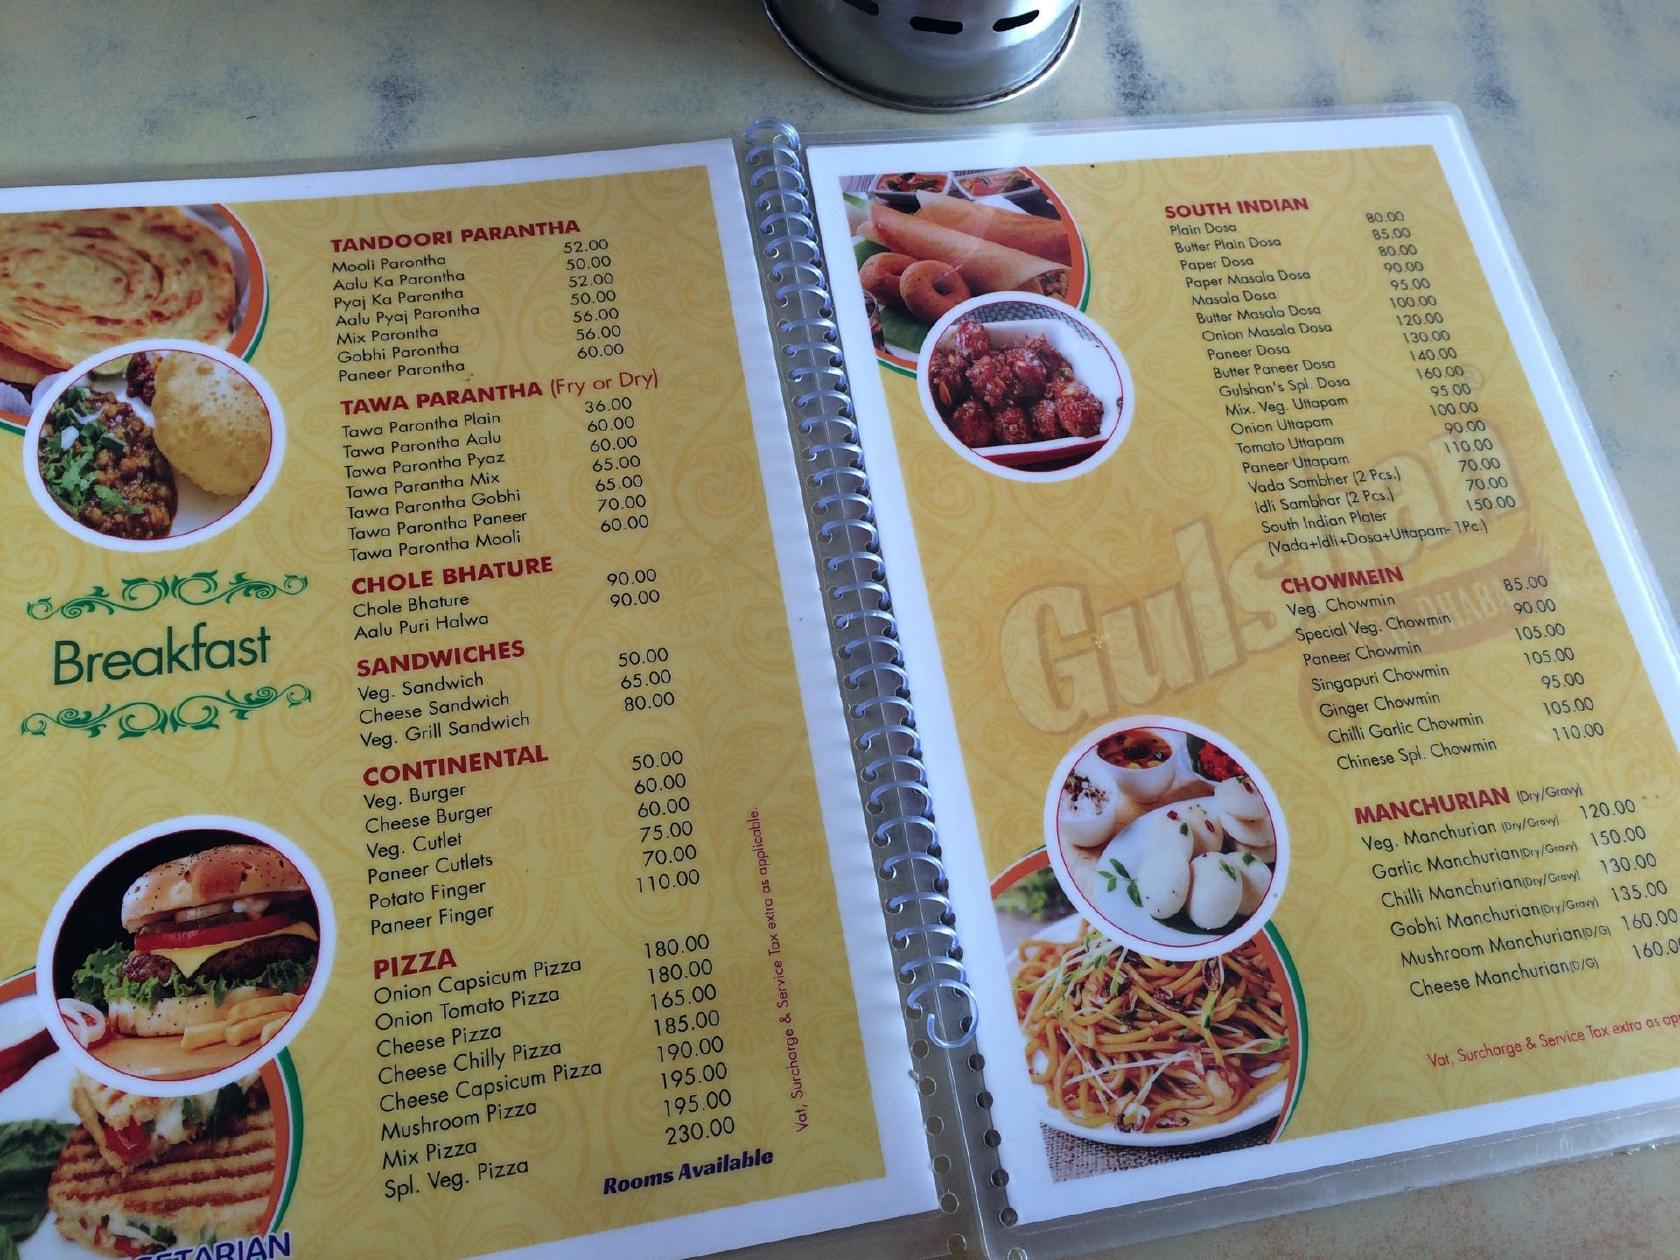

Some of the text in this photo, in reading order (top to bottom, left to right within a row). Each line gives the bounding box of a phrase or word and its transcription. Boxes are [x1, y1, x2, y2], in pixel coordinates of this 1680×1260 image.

[1164, 198, 1309, 219] SOUTH INDIAN
[1169, 211, 1404, 235] Plain Dosa 80.00
[330, 219, 581, 253] TANDOORI PARANTHA
[332, 258, 375, 273] Mooli
[563, 238, 609, 254] 52.00
[1179, 244, 1417, 272] Paper Dosa 80.00
[335, 312, 370, 327] Aalu
[376, 310, 408, 327] Pyaj
[570, 290, 616, 306] 50.00
[1192, 277, 1431, 306] Masala Dosa 95.00
[338, 369, 392, 382] Paneer
[577, 342, 624, 360] 60.00
[1207, 330, 1450, 360] Paneer Dosa 130.00
[340, 368, 658, 416] TAWA PARANTHA (Fry or Dry)
[1219, 365, 1464, 397] Gulshan's Spl. Dosa 160.00
[1225, 383, 1471, 416] Mix. Veg. Uttapam 95.00
[341, 424, 383, 438] Tawa
[464, 411, 501, 427] Plain
[584, 396, 632, 414] 36.00
[1235, 419, 1486, 454] Tomato Uttapam 90.00
[345, 485, 388, 499] Tawa
[470, 472, 500, 487] Mix
[592, 454, 641, 473] 65.00
[1261, 495, 1516, 534] South Indian Plater 150.00
[351, 556, 553, 595] CHOLE BHATURE
[353, 568, 657, 618] Chole Bhature 90.00
[1280, 566, 1404, 594] CHOWMEIN
[1285, 575, 1548, 618] Veg. Chowmin 85.00
[1295, 621, 1347, 645] Special
[1348, 620, 1383, 637] Veg.
[1385, 612, 1451, 630] Chowmin
[1513, 598, 1556, 615] 90.00
[53, 622, 271, 686] Breakfast
[357, 639, 525, 678] SANDWICHES
[357, 647, 669, 704] Veg. Sandwich 50.00
[1311, 647, 1575, 693] Singapuri Chowmin 105.00
[1319, 672, 1584, 718] Ginger Chowmin 95.00
[359, 691, 675, 750] Veg. Grill Sandwich 80.00
[363, 744, 549, 787] CONTINENTAL
[1337, 722, 1604, 770] Chinese Spl. Chowmin 110.00
[362, 750, 683, 811] Veg. Burger 50.00
[366, 796, 690, 860] Veg. Cutlet 60.00
[1354, 787, 1511, 824] MANCHURIAN
[1361, 835, 1399, 852] Veg.
[1403, 822, 1497, 845] Manchurian
[1579, 799, 1635, 819] 120.00
[368, 820, 693, 885] Paneer Cutlets 75.00
[1372, 825, 1646, 880] Garlic 150.00
[371, 868, 700, 936] Paneer Finger 110.00
[762, 879, 771, 894] as
[1381, 852, 1656, 908] Chilli 130.00
[764, 898, 777, 930] extra
[1390, 880, 1668, 937] Gobhi 135.00
[768, 933, 781, 957] Tax
[1401, 908, 1678, 968] Mushroom 160.00
[374, 948, 458, 980] PIZZA
[374, 933, 710, 1005] Onion Capsicum Pizza 180.00
[773, 960, 789, 1009] Service
[376, 983, 717, 1058] Cheese Pizza 165.00
[779, 1011, 792, 1024] &
[1457, 1042, 1522, 1063] Surcharge
[1526, 1036, 1537, 1050] &
[1538, 1031, 1585, 1048] Service
[1586, 1024, 1608, 1039] Tax
[1612, 1019, 1642, 1034] extra
[1646, 1017, 1660, 1029] as
[378, 1009, 720, 1085] Cheese Chilly Pizza 185.00
[786, 1028, 803, 1099] Surcharge
[381, 1061, 727, 1142] Mushroom Pizza 195.00
[384, 1116, 735, 1202] Spl. Veg. Pizza 230.00
[603, 1148, 774, 1195] Rooms Available
